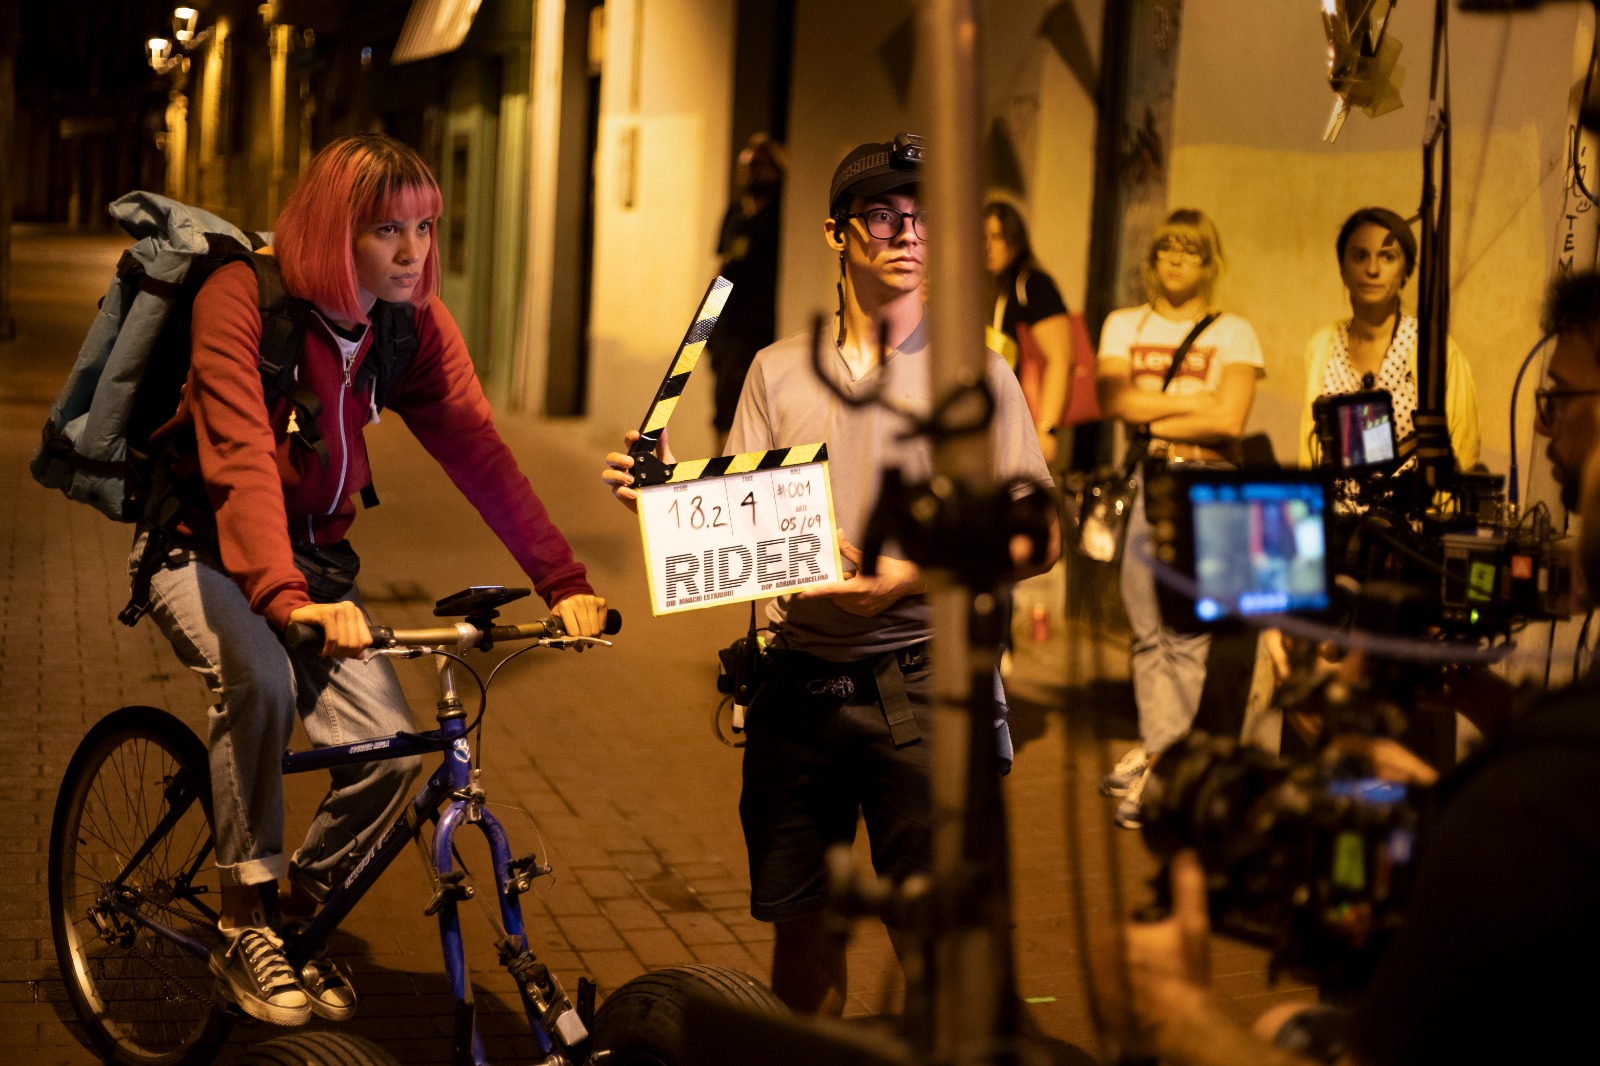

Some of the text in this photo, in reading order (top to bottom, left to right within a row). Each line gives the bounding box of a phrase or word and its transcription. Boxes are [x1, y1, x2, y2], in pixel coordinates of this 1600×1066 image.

[777, 480, 811, 497] #001
[740, 491, 757, 526] 4
[665, 533, 821, 599] RIDER
[761, 583, 773, 591] DOP
[797, 573, 829, 585] BARCELONA
[679, 595, 703, 606] IGNACIO
